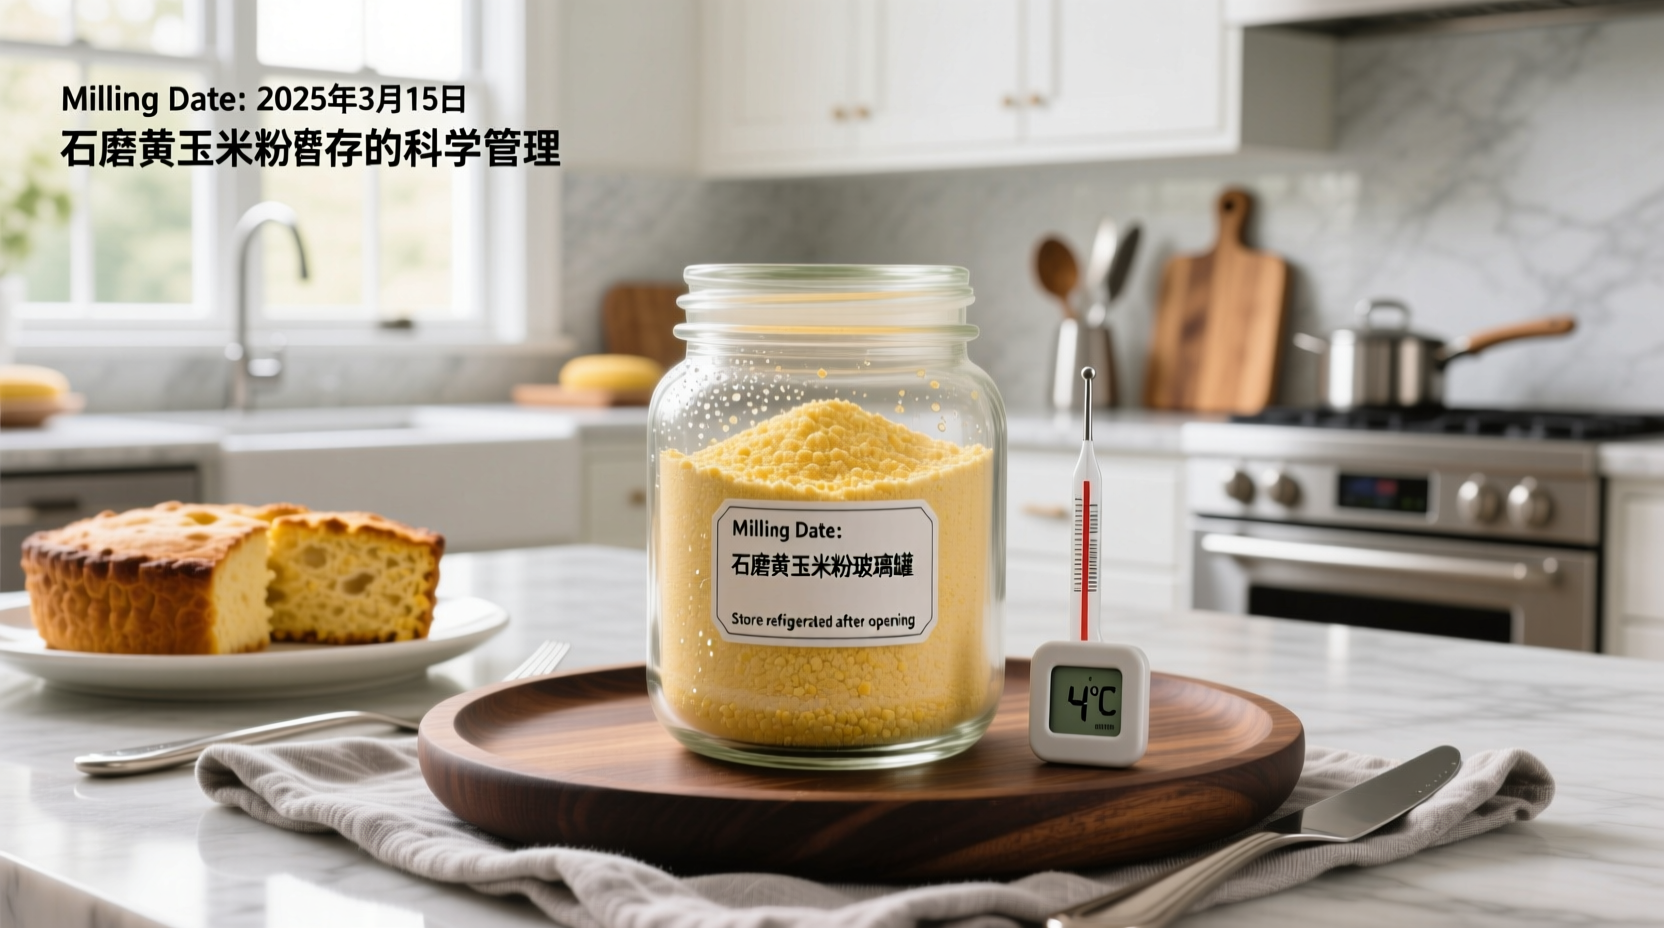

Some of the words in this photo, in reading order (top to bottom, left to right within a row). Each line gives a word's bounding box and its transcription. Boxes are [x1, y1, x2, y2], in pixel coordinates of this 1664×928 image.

[732, 518, 790, 543] Milling
[795, 521, 842, 539] Date:
[731, 611, 764, 627] Store
[835, 614, 865, 628] after
[868, 613, 916, 631] opening
[1067, 685, 1117, 722] 4°C
